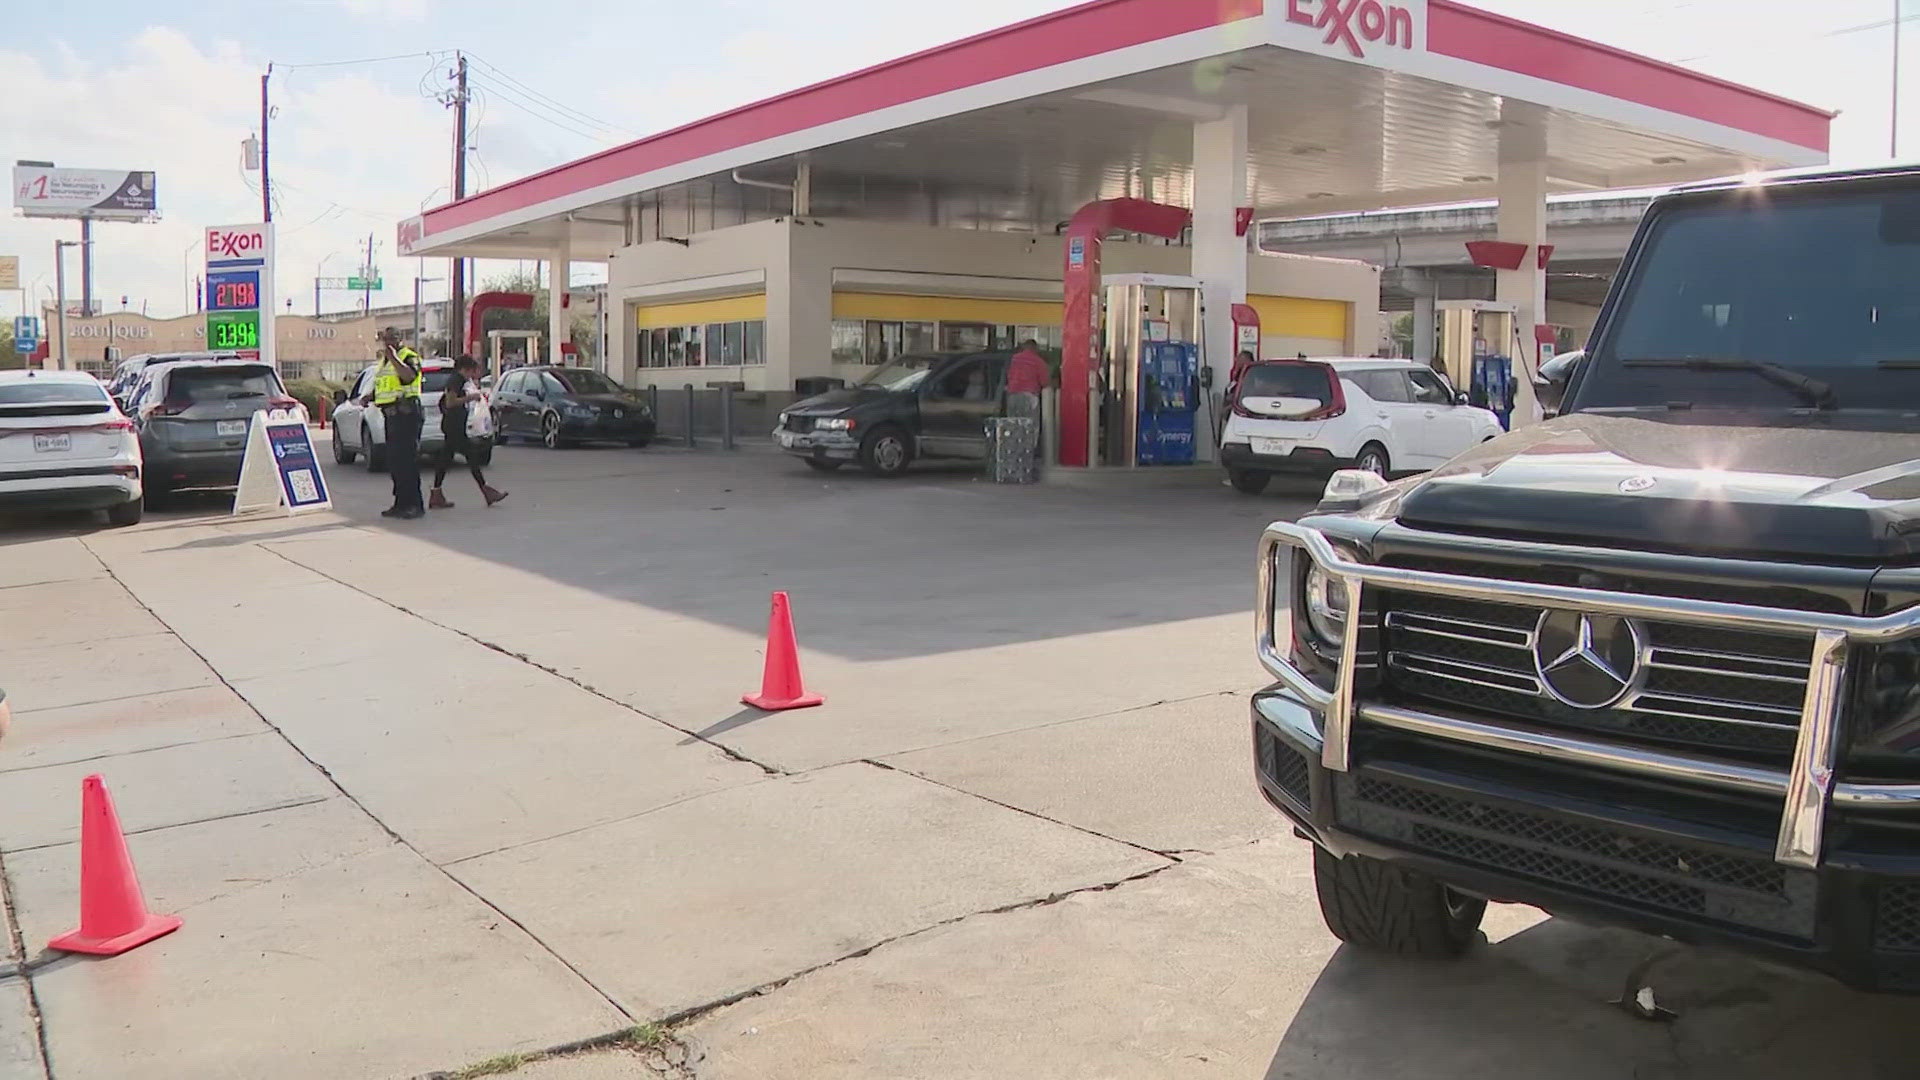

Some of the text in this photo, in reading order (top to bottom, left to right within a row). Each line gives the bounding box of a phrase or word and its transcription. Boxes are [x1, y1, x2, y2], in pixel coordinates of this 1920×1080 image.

[209, 231, 263, 257] Exxon
[18, 318, 36, 337] H
[308, 327, 337, 340] DVD
